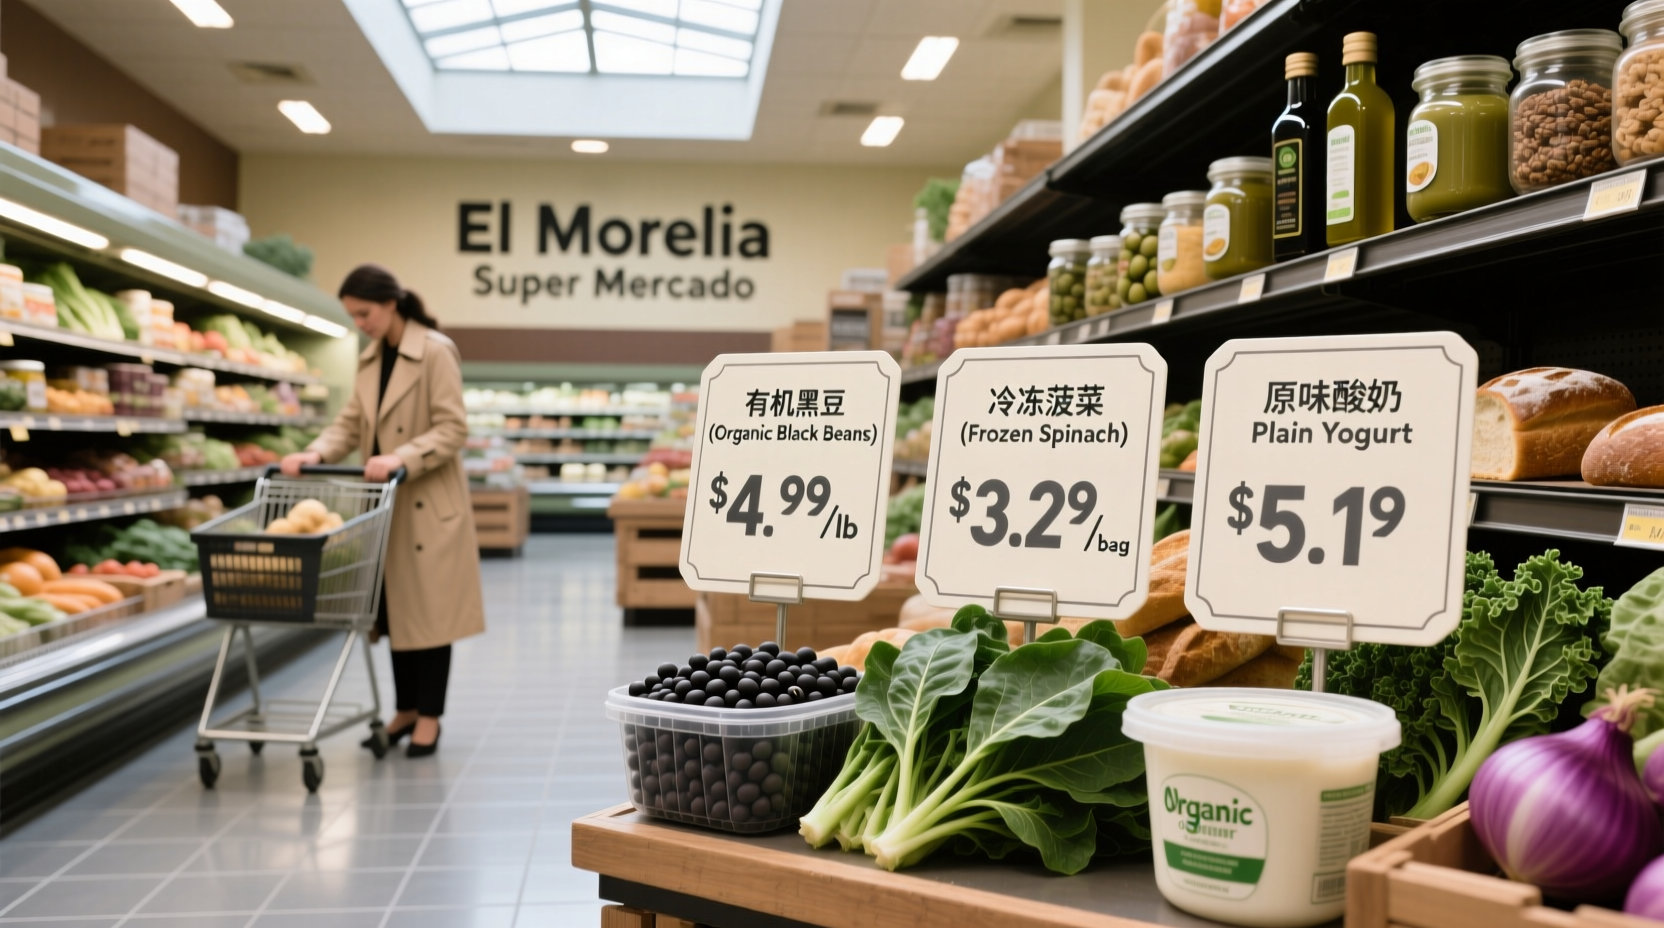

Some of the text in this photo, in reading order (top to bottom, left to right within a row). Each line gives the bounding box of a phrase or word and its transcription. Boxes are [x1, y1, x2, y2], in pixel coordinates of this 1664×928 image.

[458, 202, 770, 258] El Morelia
[473, 265, 755, 305] Super Mercado
[745, 388, 846, 418] 有机黑豆
[988, 384, 1105, 417] 冷冻菠菜
[1263, 378, 1402, 414] 原味酸奶
[708, 423, 878, 447] (Organic Black Beans)
[960, 421, 1128, 449] (Frozen Spinach)
[1252, 420, 1413, 451] Plain Yogurt
[1227, 481, 1406, 566] $5.19
[1164, 786, 1253, 834] Organic
